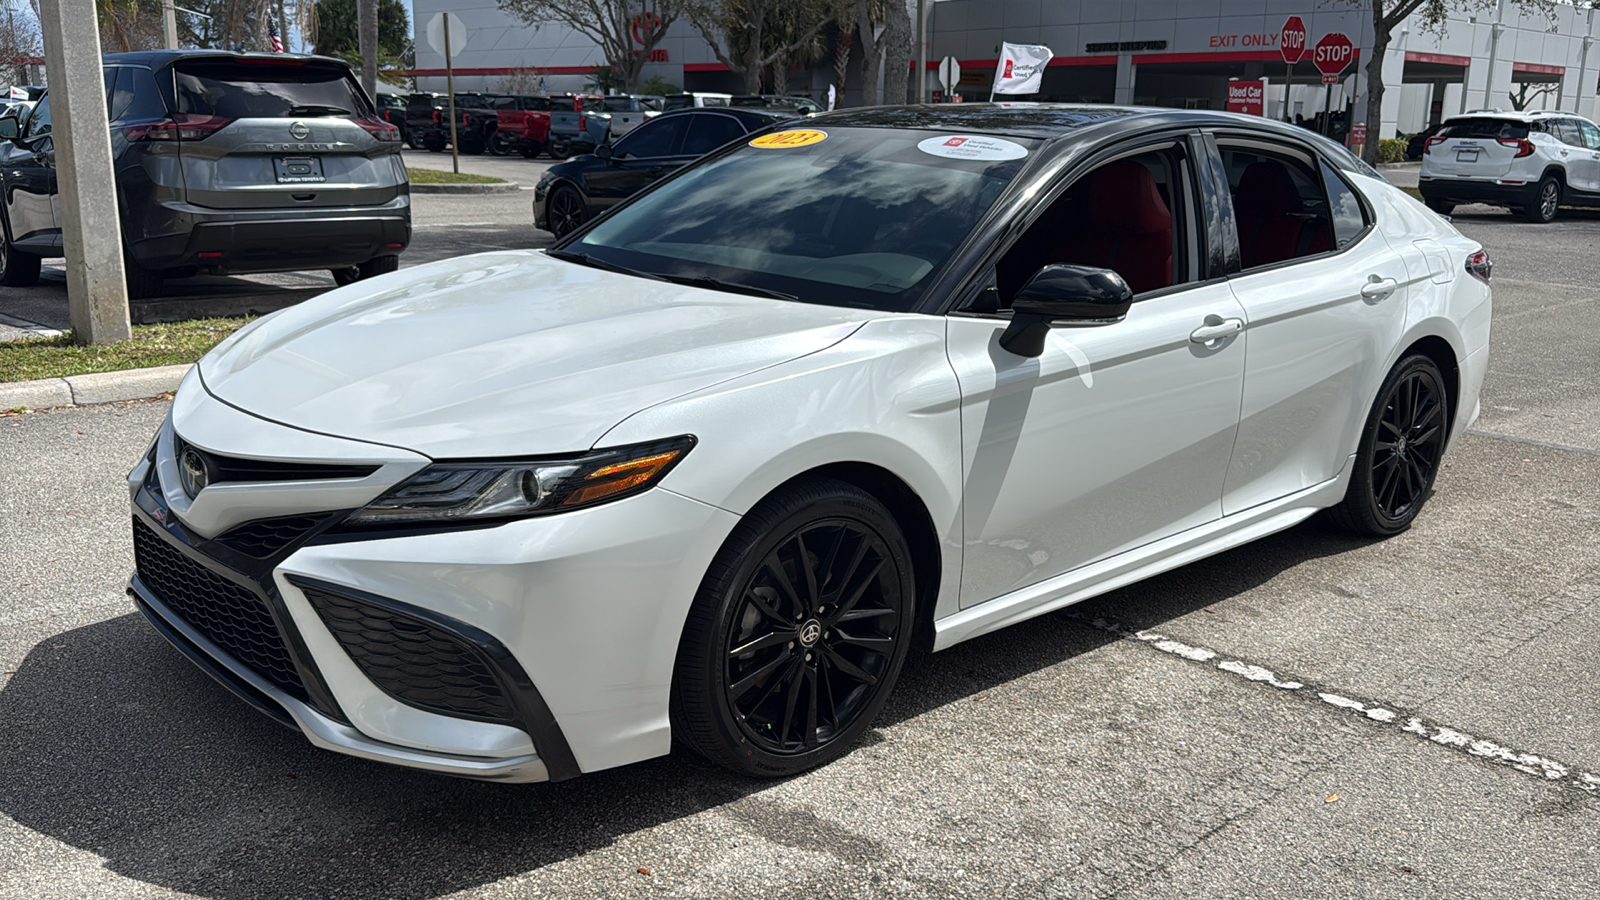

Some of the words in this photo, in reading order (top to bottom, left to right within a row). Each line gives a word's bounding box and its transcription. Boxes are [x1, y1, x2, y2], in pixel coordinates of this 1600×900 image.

[1209, 35, 1238, 47] EXIT
[1241, 33, 1279, 46] ONLY
[1282, 30, 1304, 48] STOP
[633, 49, 669, 62] TOTA
[1316, 45, 1350, 62] STOP
[1229, 87, 1247, 97] Used
[1248, 86, 1262, 97] Car
[756, 133, 819, 144] 2023
[842, 500, 875, 515] VELOCITY
